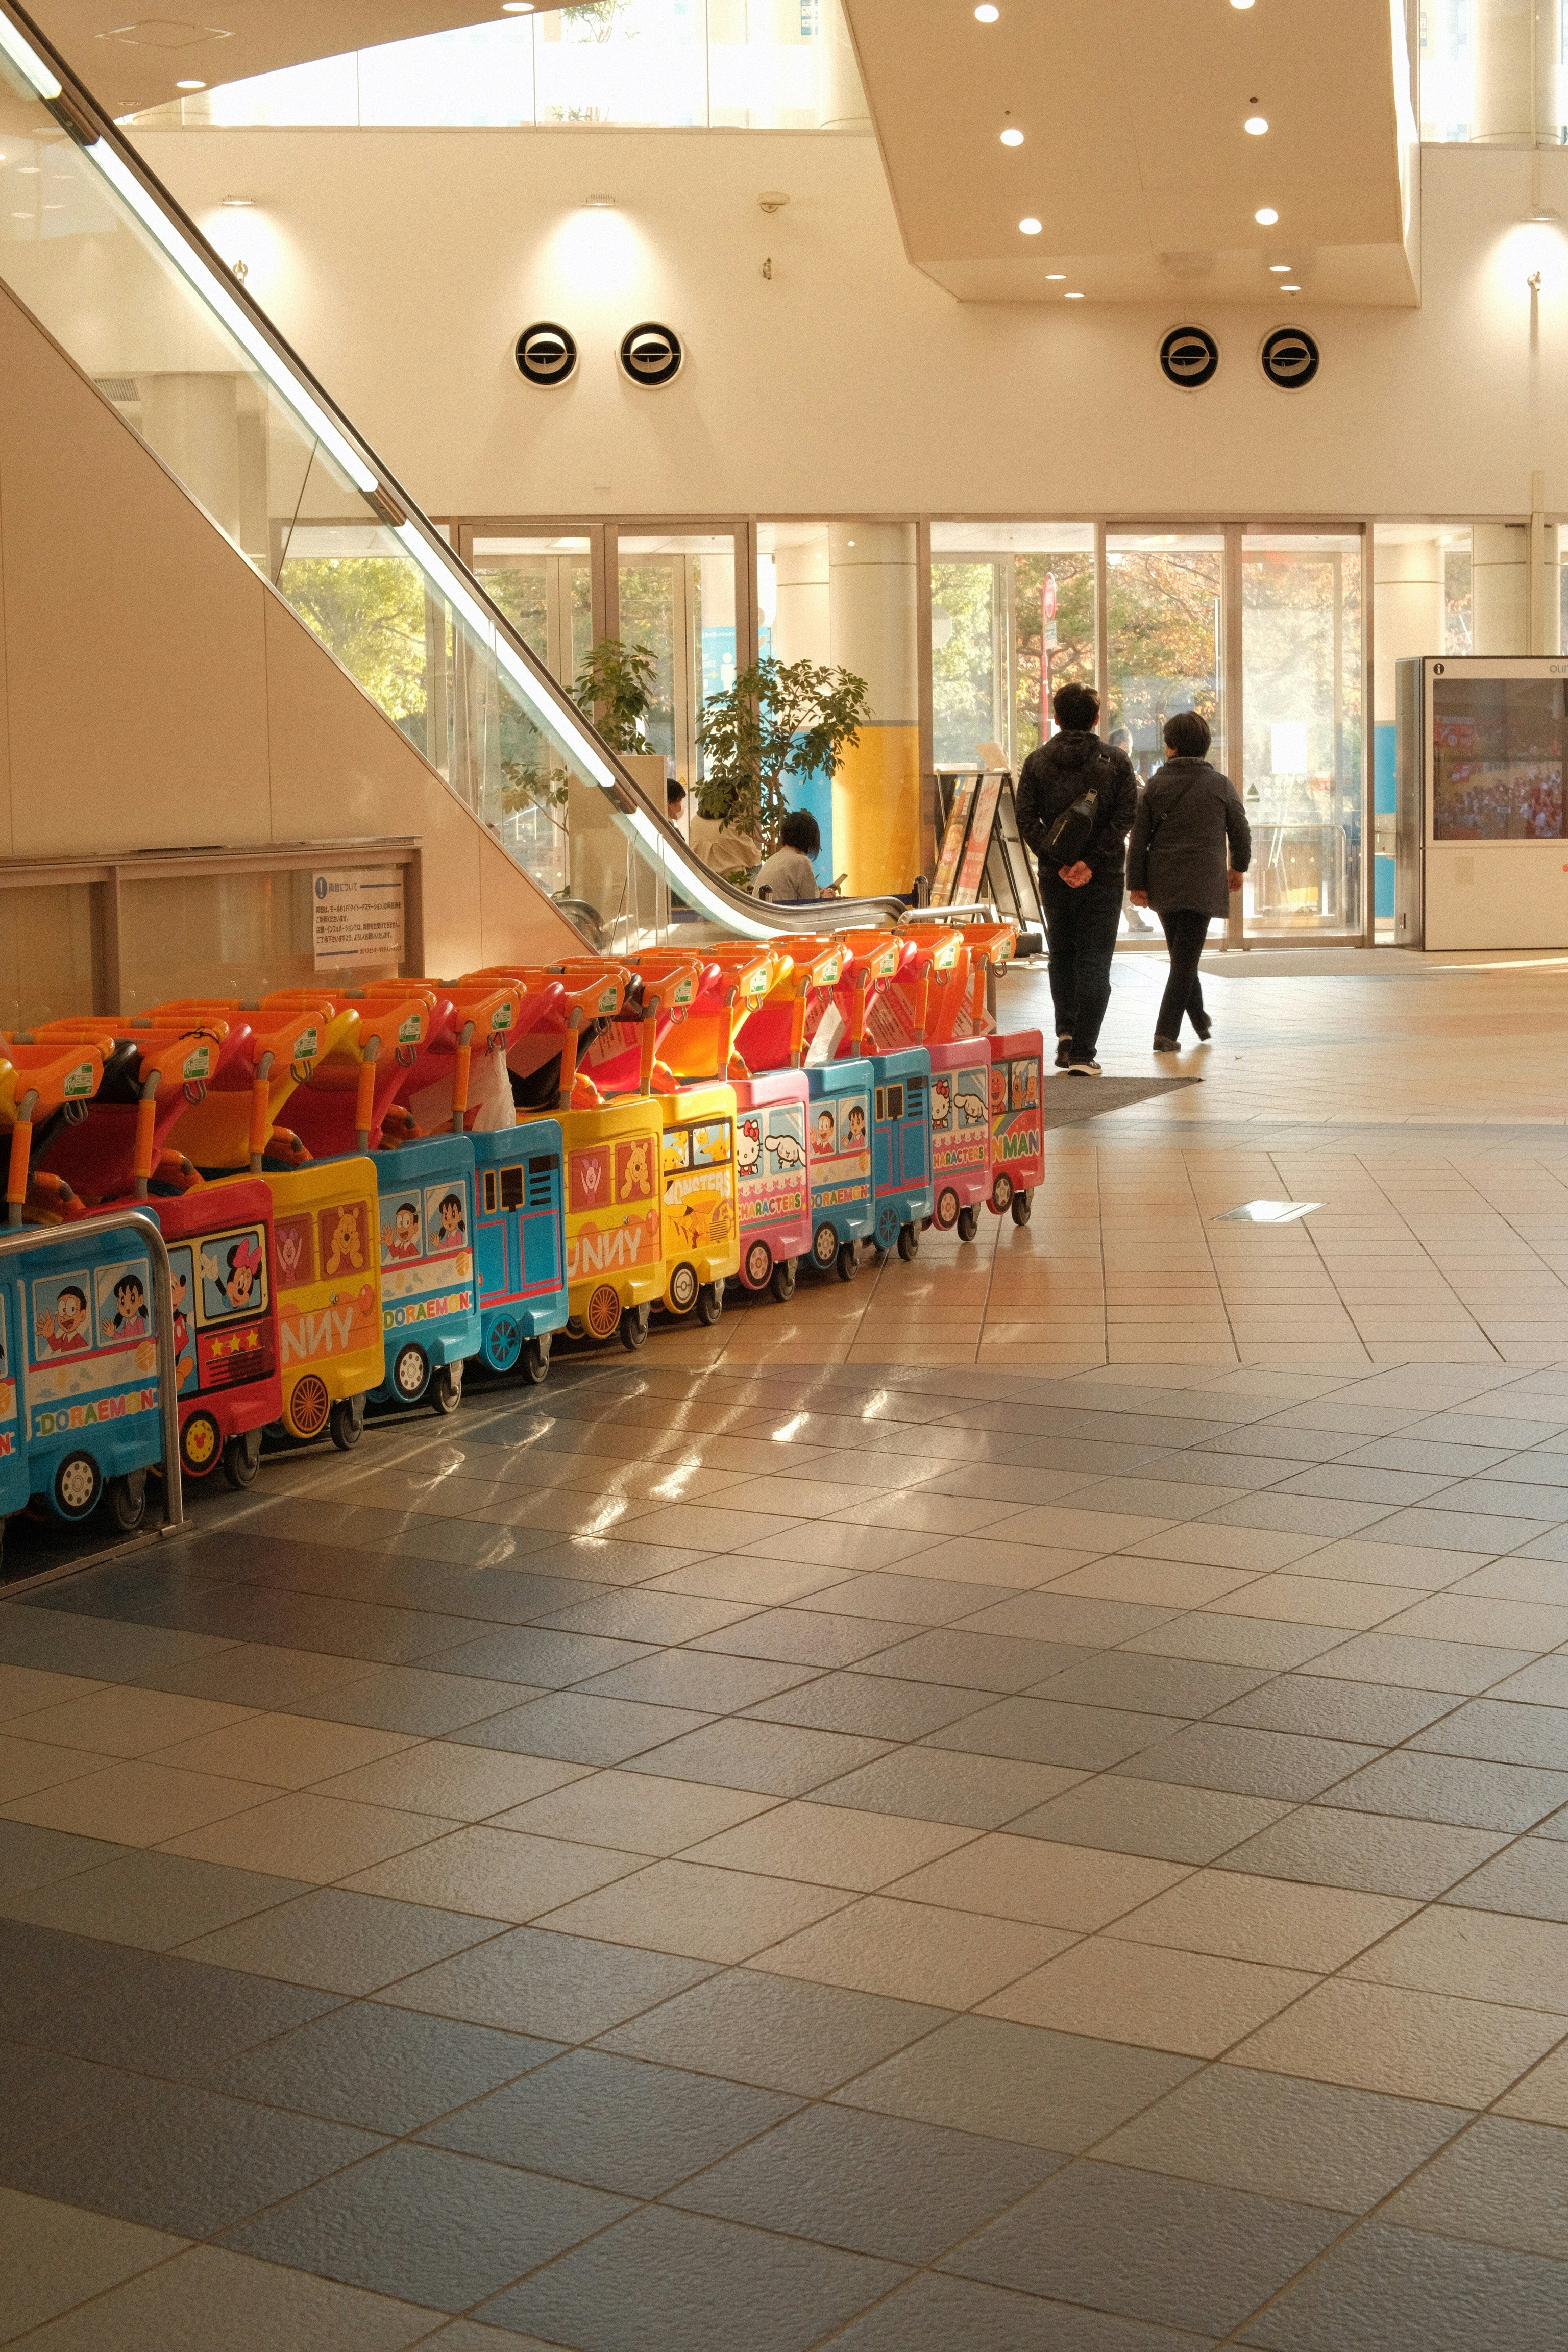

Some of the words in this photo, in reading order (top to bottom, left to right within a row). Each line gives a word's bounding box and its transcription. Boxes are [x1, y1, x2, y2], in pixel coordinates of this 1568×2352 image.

[328, 882, 358, 892] 両替について
[738, 1193, 801, 1219] HARACTERS
[383, 1291, 469, 1329] DORAEMON
[40, 1388, 154, 1435] DORAEMON
